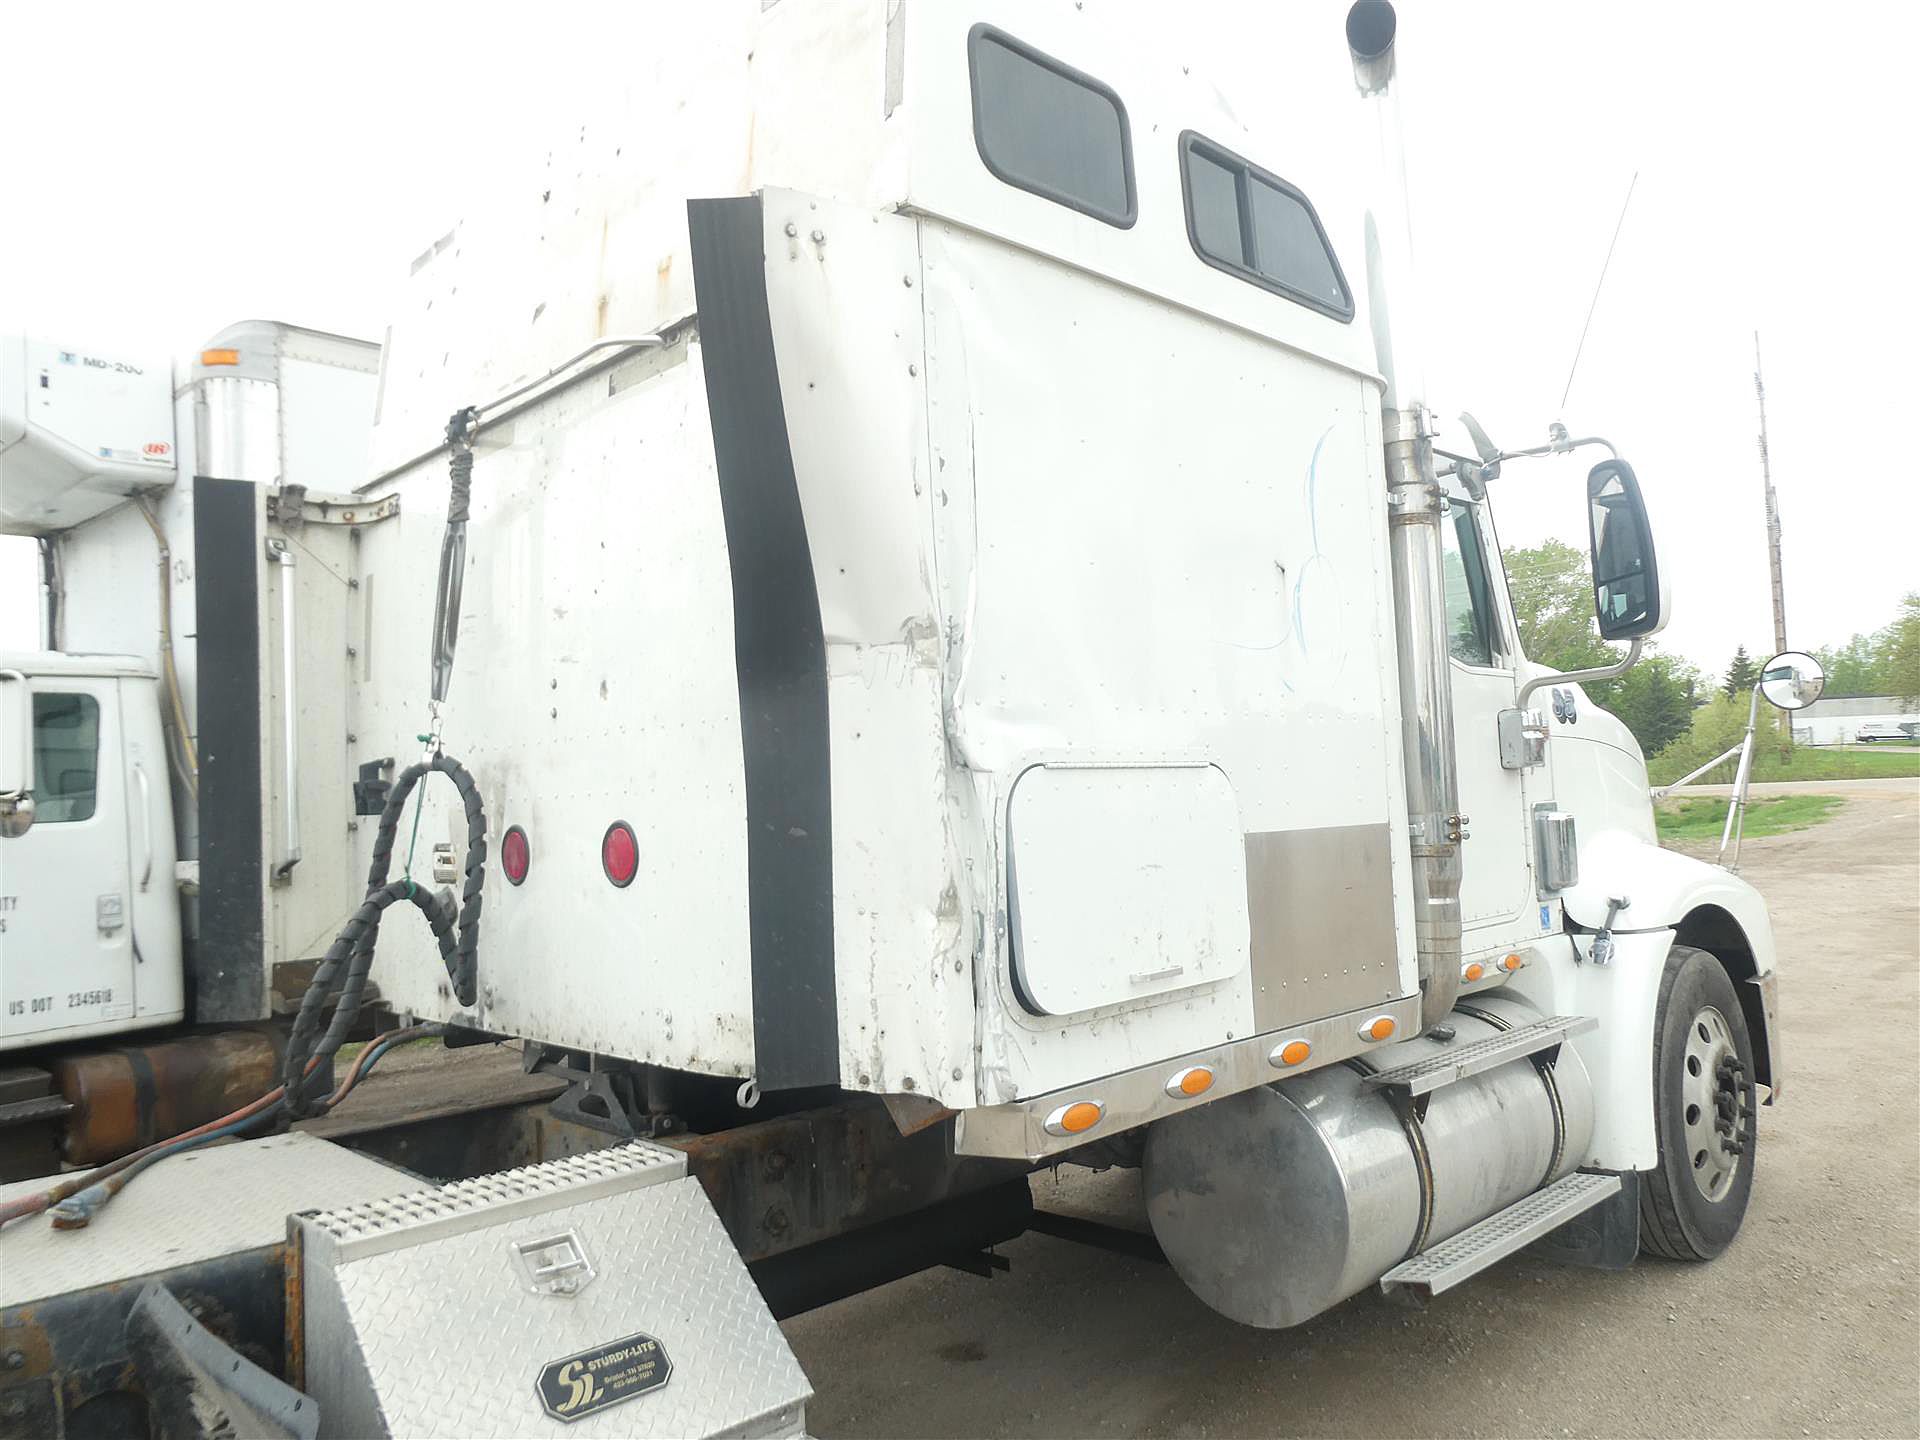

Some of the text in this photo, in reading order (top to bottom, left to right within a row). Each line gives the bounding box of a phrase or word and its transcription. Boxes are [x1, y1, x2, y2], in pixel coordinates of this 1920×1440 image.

[9, 1000, 24, 1015] US
[31, 996, 53, 1013] DOT
[588, 1341, 656, 1371] STURDY-LITE
